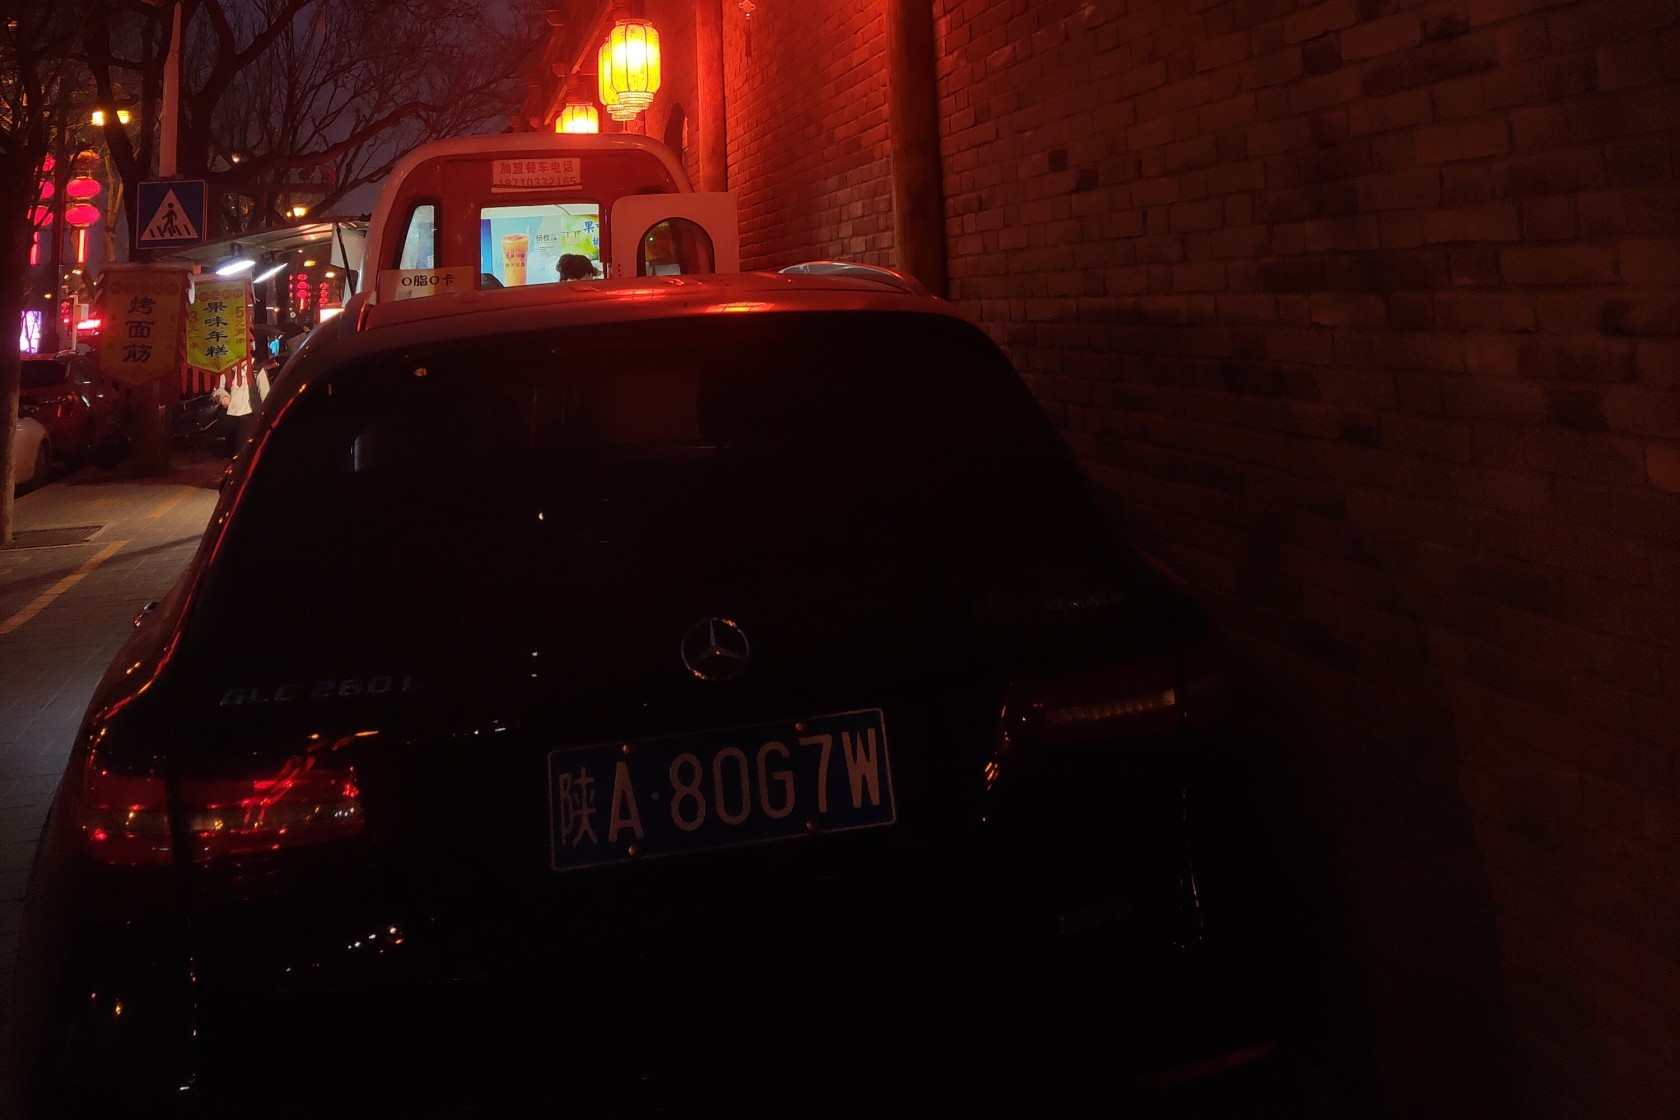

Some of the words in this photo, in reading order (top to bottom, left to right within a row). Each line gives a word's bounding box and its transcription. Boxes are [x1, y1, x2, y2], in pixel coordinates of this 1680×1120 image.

[500, 161, 575, 174] 加盟餐车电话
[122, 296, 156, 363] 烤面筋
[203, 301, 229, 357] 果味年糕
